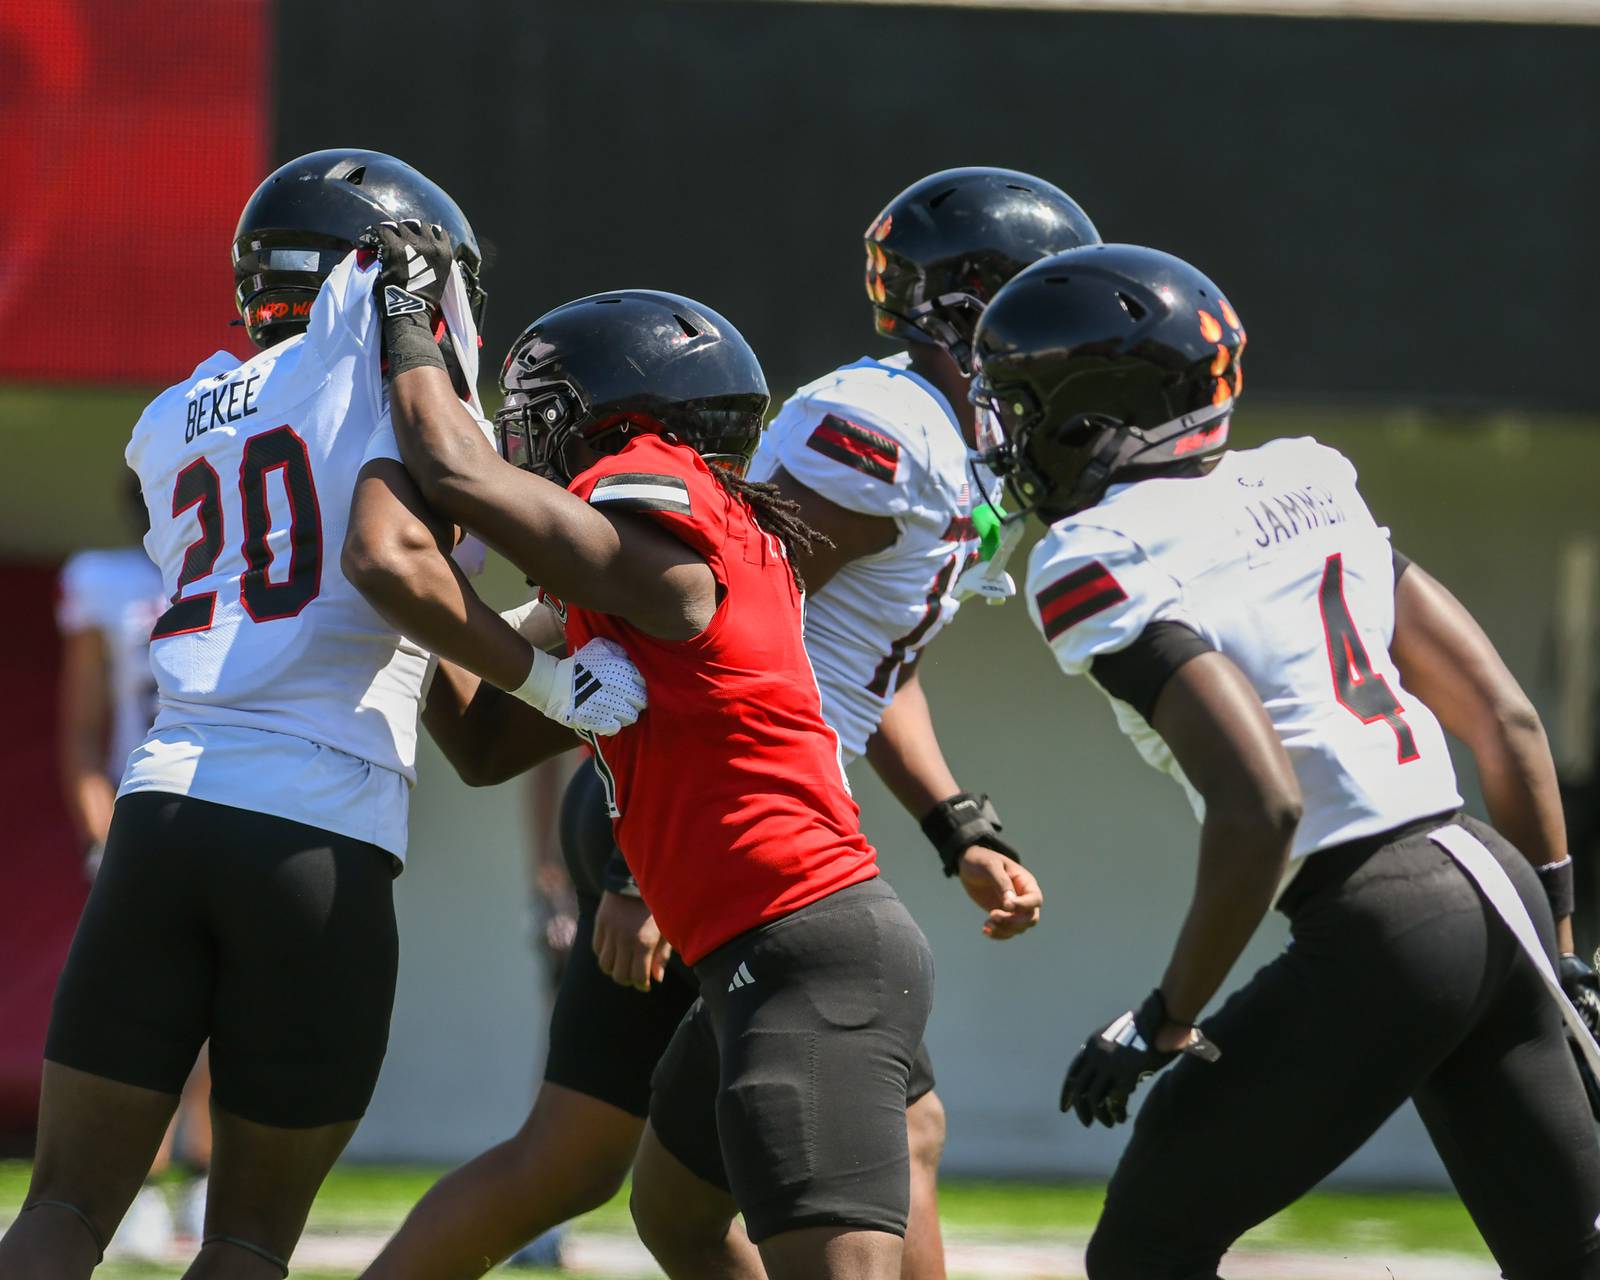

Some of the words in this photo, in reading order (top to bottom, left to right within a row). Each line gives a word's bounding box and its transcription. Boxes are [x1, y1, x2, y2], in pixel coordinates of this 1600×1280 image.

[185, 375, 260, 444] BEKEE
[150, 424, 323, 640] 20
[1319, 552, 1421, 764] 4
